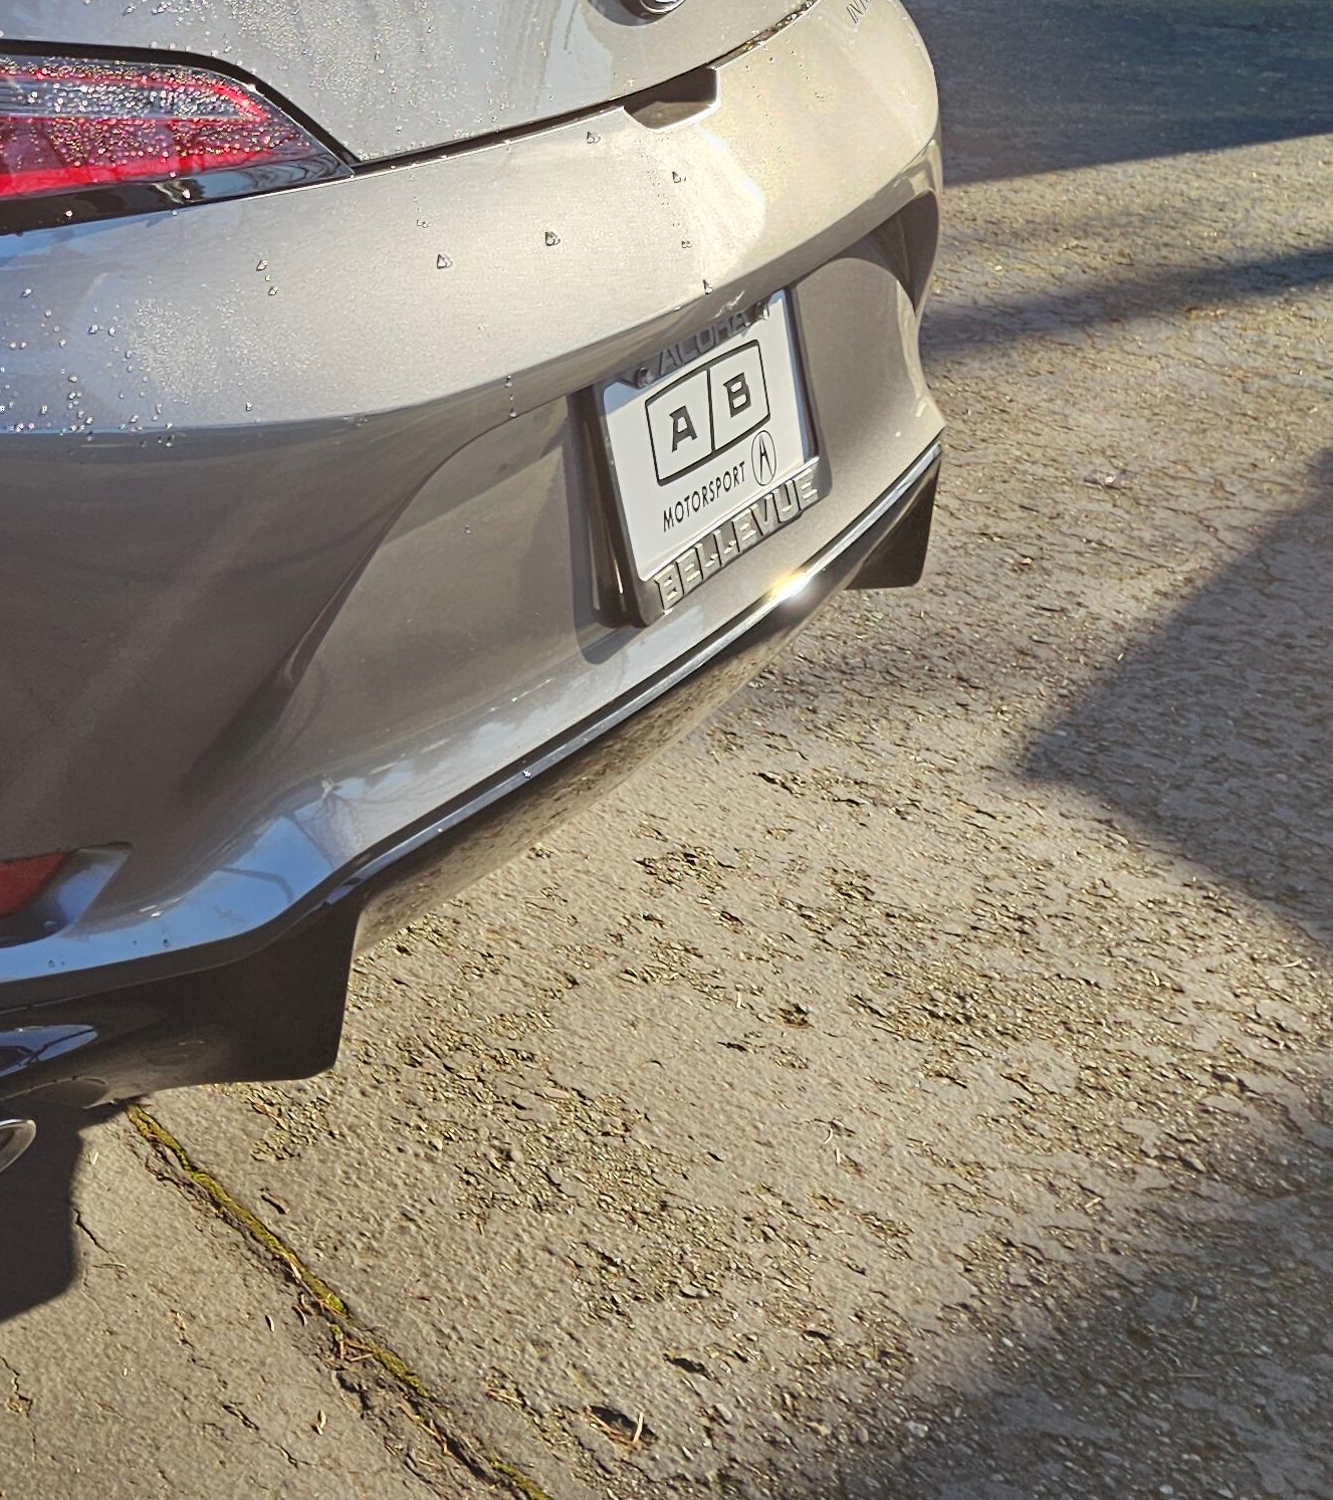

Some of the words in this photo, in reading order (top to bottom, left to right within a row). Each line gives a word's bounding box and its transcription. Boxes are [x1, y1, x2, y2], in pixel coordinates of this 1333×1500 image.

[669, 405, 698, 453] A
[722, 372, 752, 418] B
[663, 461, 746, 532] MOTORSPORT
[654, 467, 819, 615] BELLEVUE
